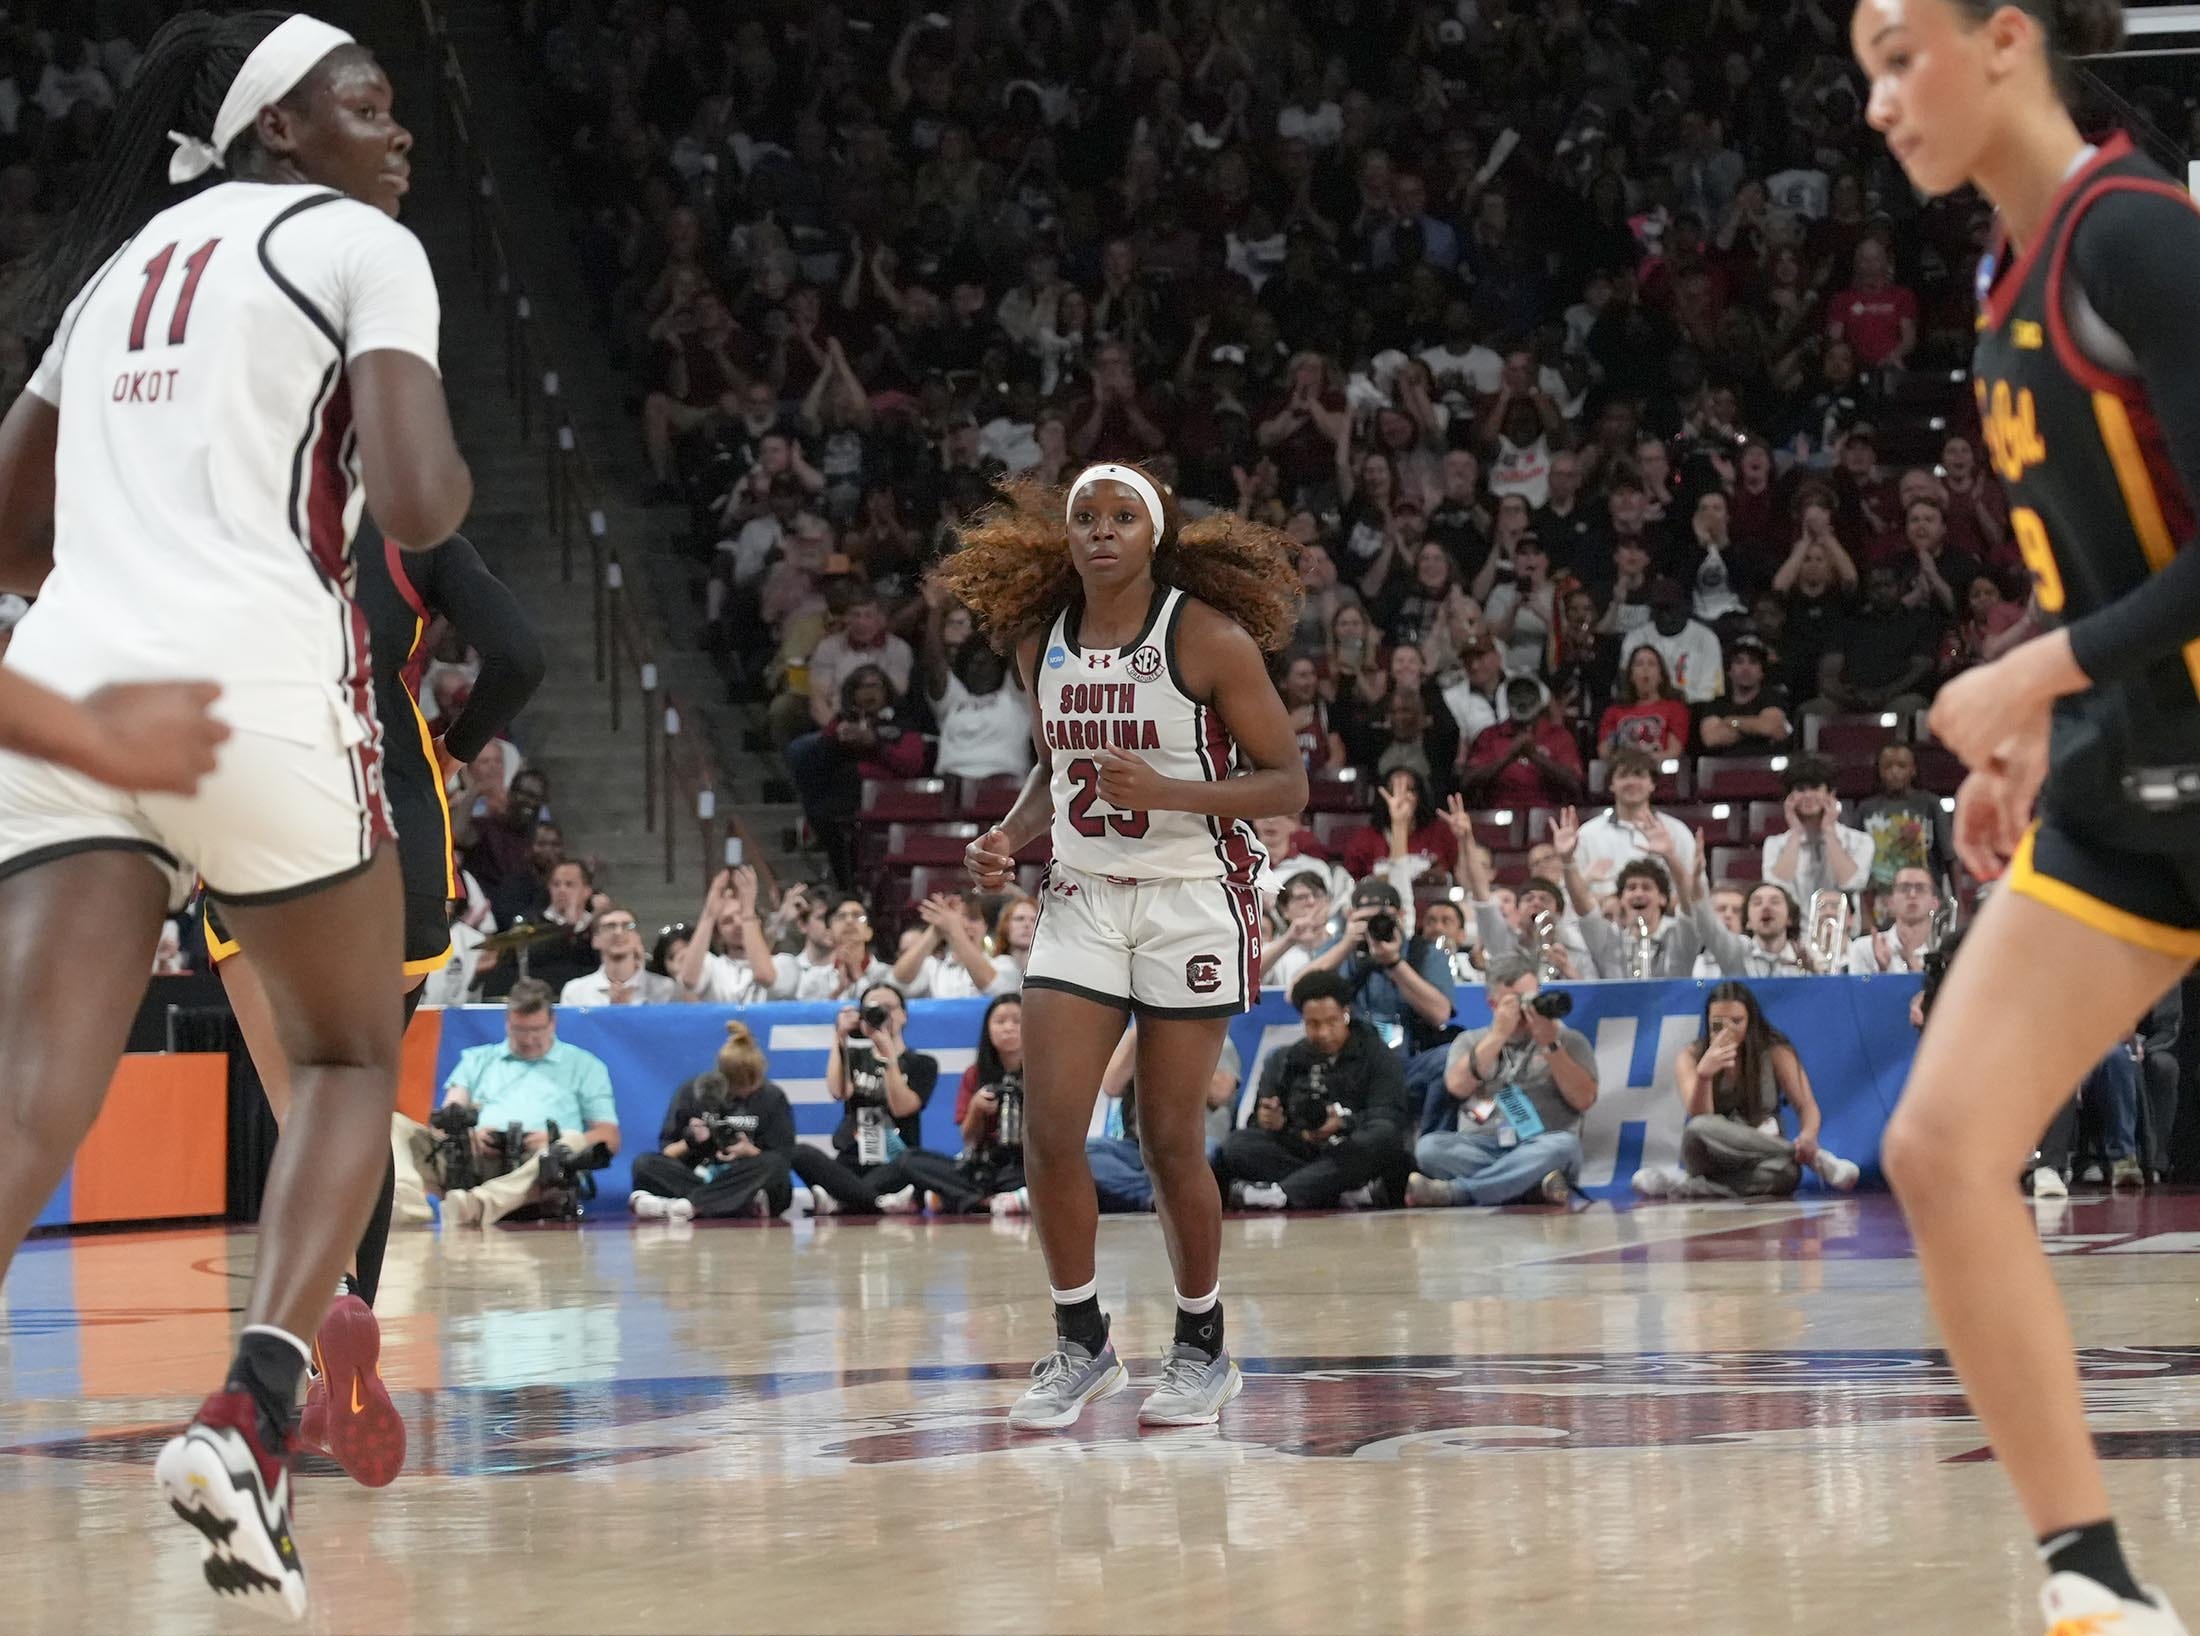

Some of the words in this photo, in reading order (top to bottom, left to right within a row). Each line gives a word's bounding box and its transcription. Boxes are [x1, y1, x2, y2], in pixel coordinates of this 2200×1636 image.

[128, 238, 222, 352] 11
[112, 369, 179, 402] OKOT
[1134, 647, 1160, 672] SEC
[1060, 684, 1134, 714] SOUTH
[1046, 720, 1160, 749] CAROLINA
